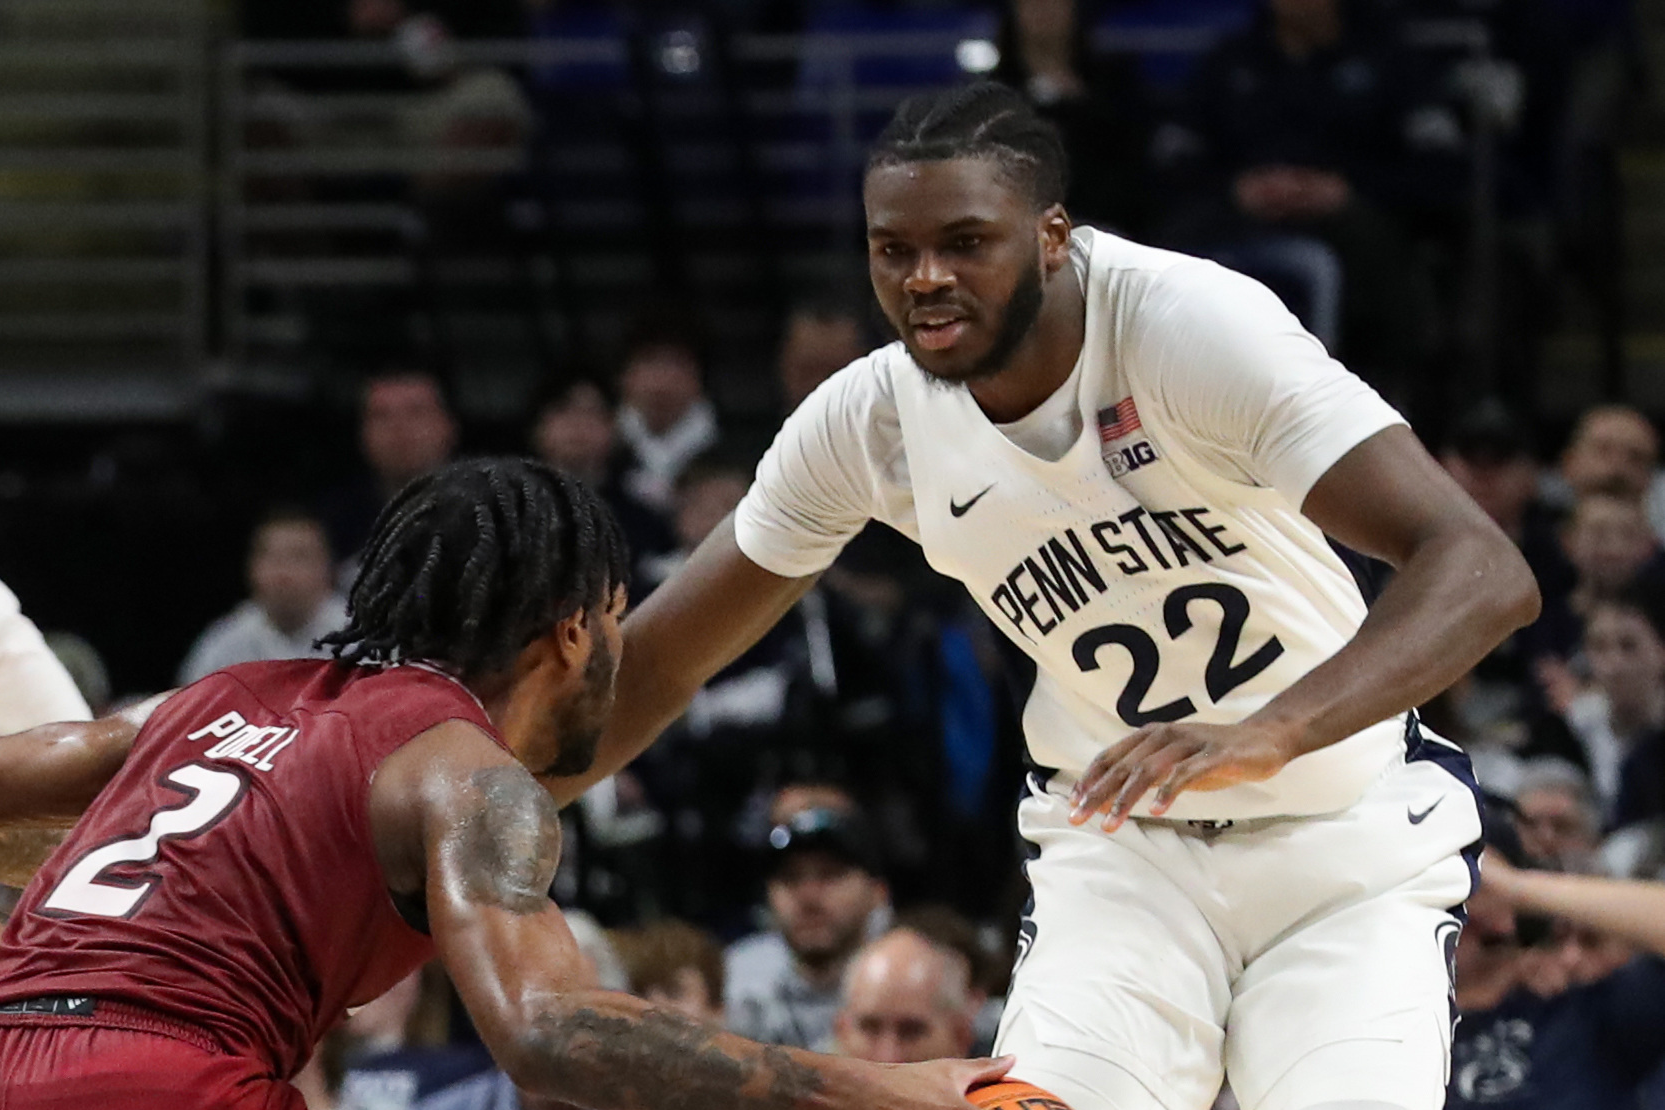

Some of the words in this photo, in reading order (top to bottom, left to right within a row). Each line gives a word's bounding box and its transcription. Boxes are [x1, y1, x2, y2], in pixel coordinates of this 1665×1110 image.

[990, 527, 1109, 646] PENN
[1090, 505, 1248, 576] STATE
[1071, 582, 1286, 728] 22
[186, 710, 300, 772] POELL
[40, 761, 244, 918] 2
